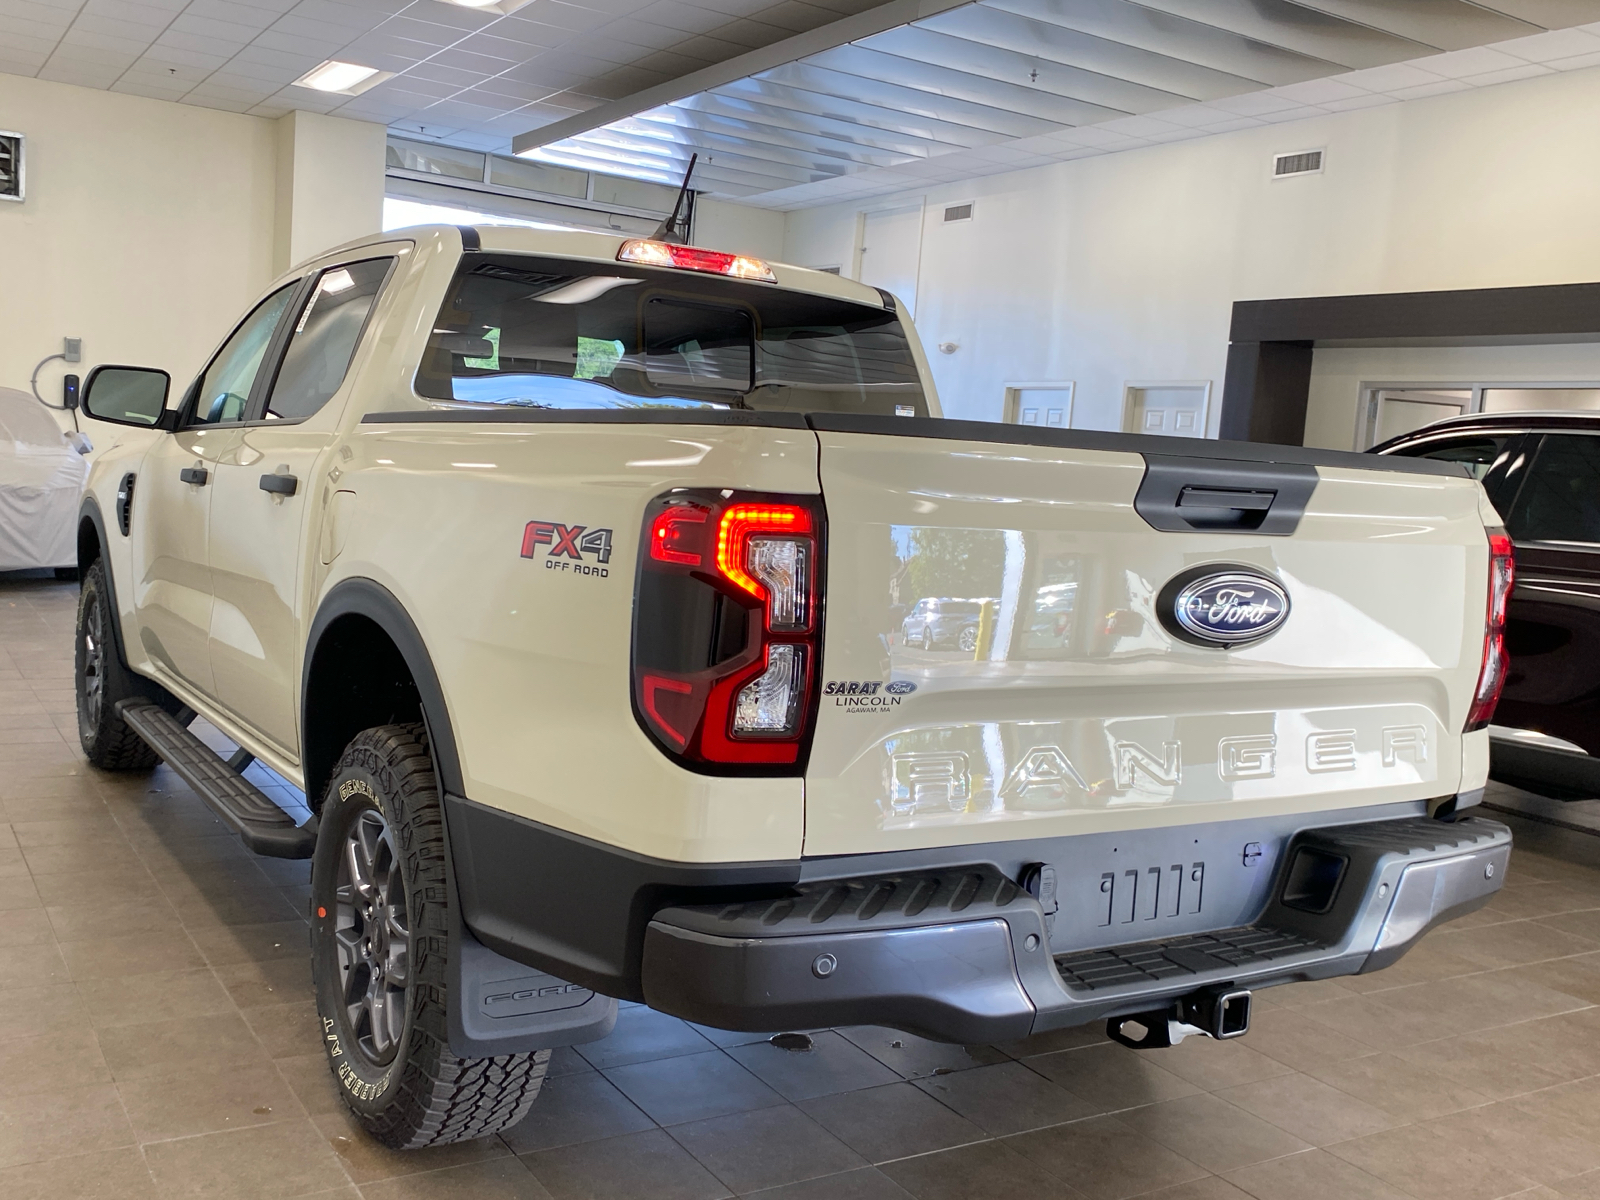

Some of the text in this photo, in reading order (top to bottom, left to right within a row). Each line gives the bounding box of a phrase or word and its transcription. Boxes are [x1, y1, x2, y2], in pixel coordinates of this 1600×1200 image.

[520, 520, 613, 564] FX4
[546, 560, 609, 578] OFF ROAD
[1208, 589, 1268, 624] Ford
[823, 681, 882, 696] SARAT
[835, 696, 901, 706] LINCOLN
[891, 724, 1428, 806] RANGER
[323, 1016, 343, 1057] A/T
